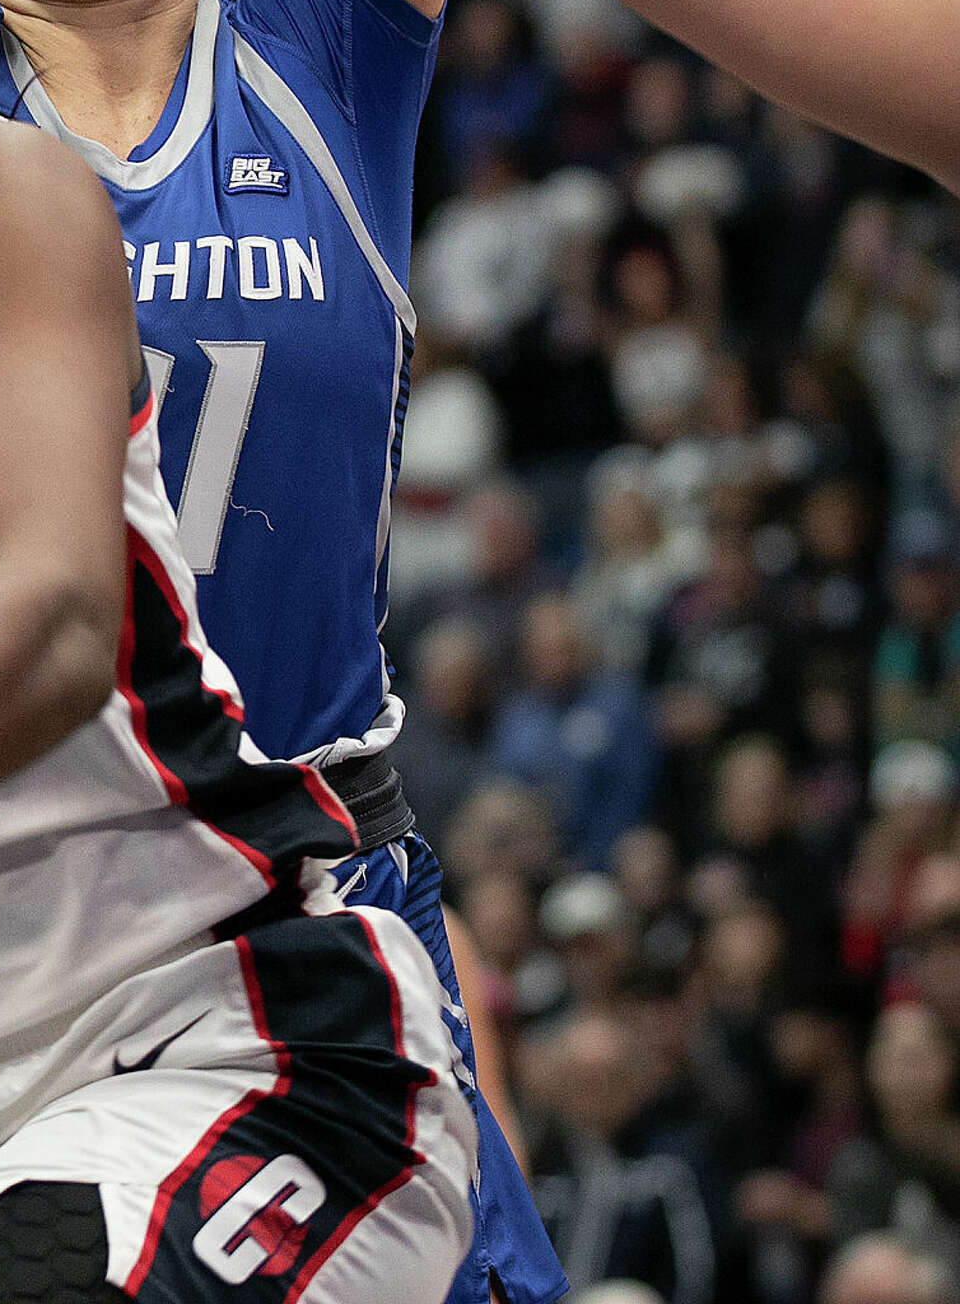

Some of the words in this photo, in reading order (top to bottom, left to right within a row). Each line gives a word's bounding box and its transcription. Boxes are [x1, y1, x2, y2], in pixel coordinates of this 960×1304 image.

[231, 157, 271, 171] BIG
[230, 170, 285, 183] EAST
[142, 340, 266, 575] 1
